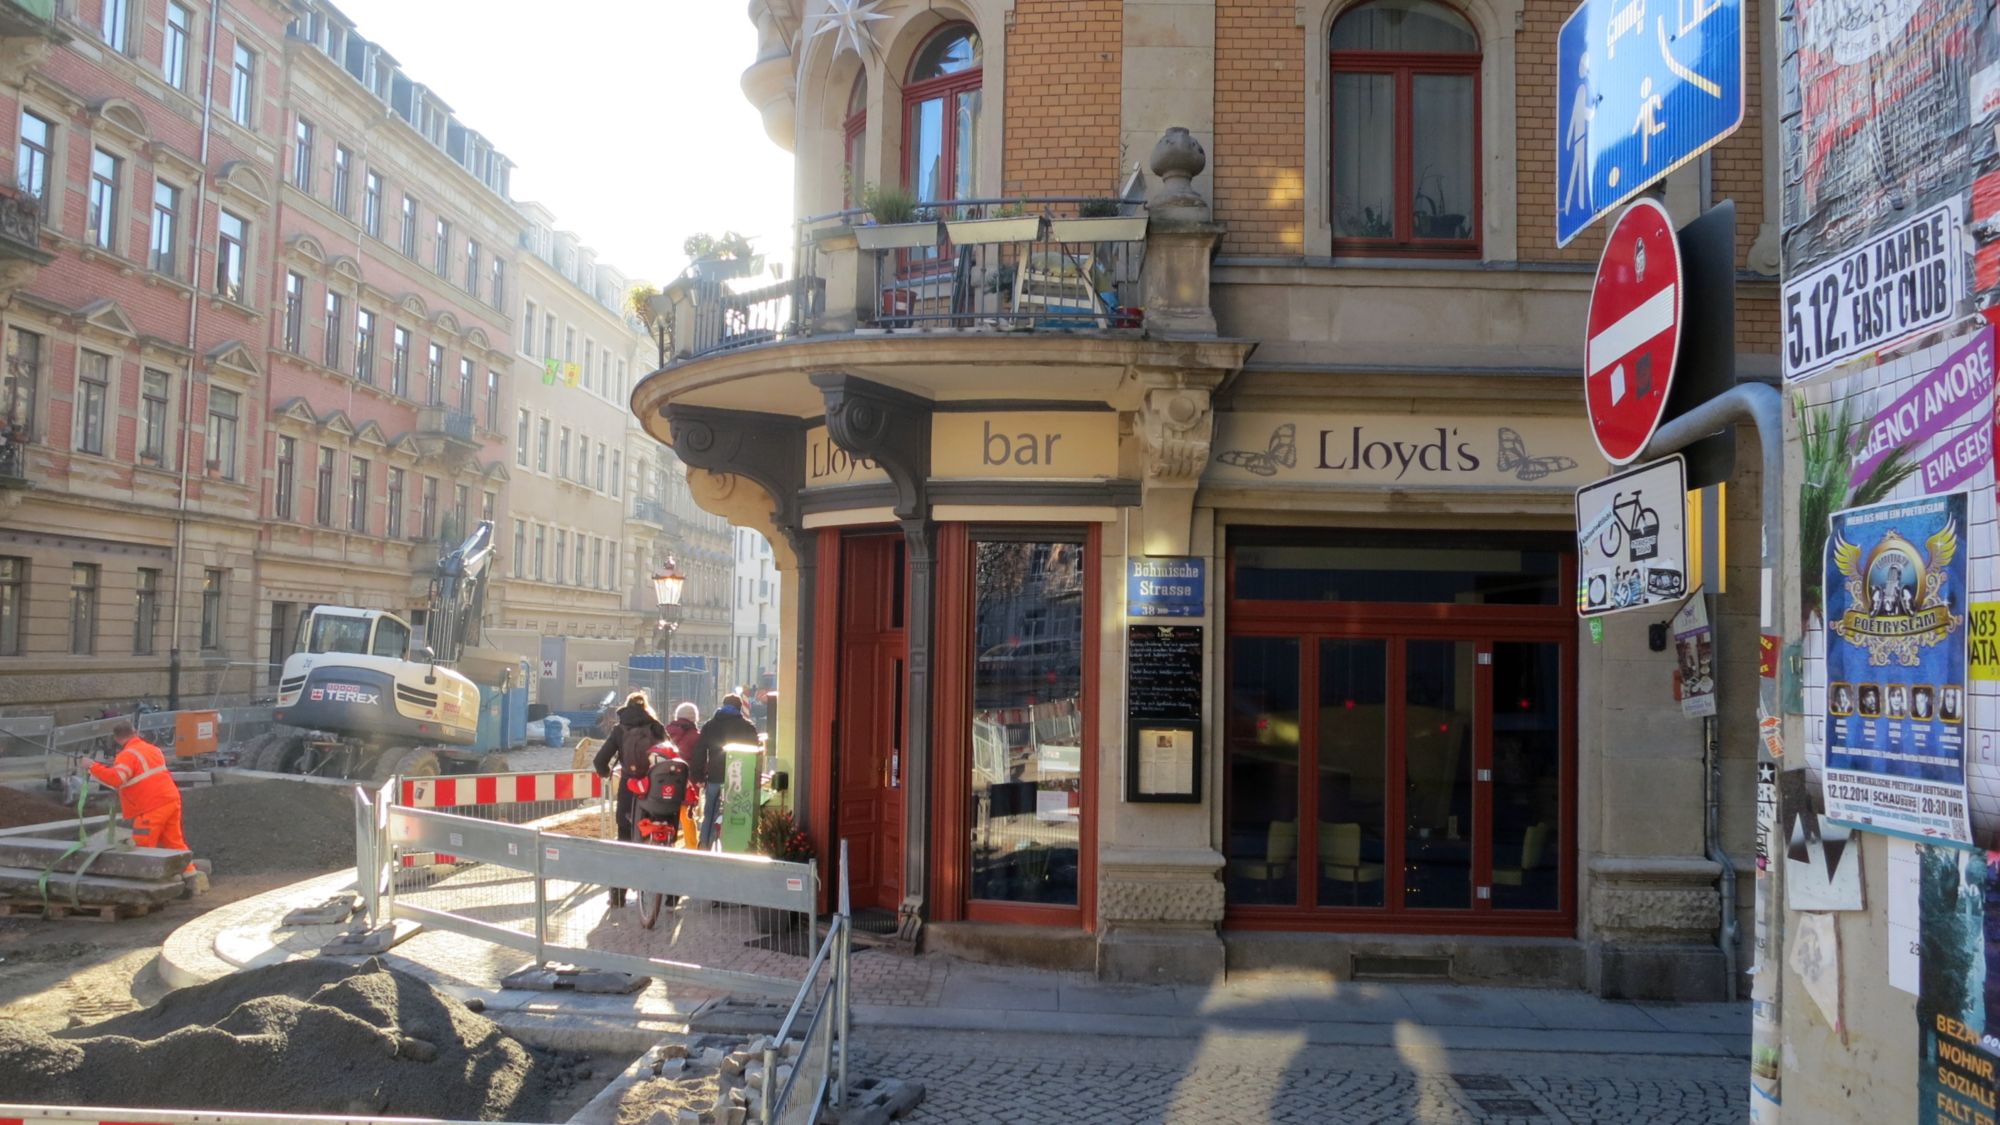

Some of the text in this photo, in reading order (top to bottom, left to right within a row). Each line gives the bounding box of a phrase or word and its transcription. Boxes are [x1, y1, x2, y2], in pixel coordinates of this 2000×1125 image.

[1842, 215, 1944, 298] 20 JAHRE
[1786, 258, 1948, 370] 5.12. EAST CLUB
[1924, 342, 1991, 422] AMORE
[983, 420, 1062, 466] bar
[1315, 426, 1480, 480] Lloyd's
[1926, 450, 1957, 488] EVA
[1133, 562, 1199, 578] Böhmische
[1140, 580, 1192, 596] Strasse
[1854, 612, 1937, 633] POETRYSLAM
[327, 691, 380, 706] TEREX
[1827, 784, 1869, 802] 12.12.2014
[1922, 797, 1946, 816] 20:30
[1948, 802, 1964, 819] UHR
[1937, 1067, 1996, 1110] SOZIALE
[1937, 1093, 1971, 1123] FALT
